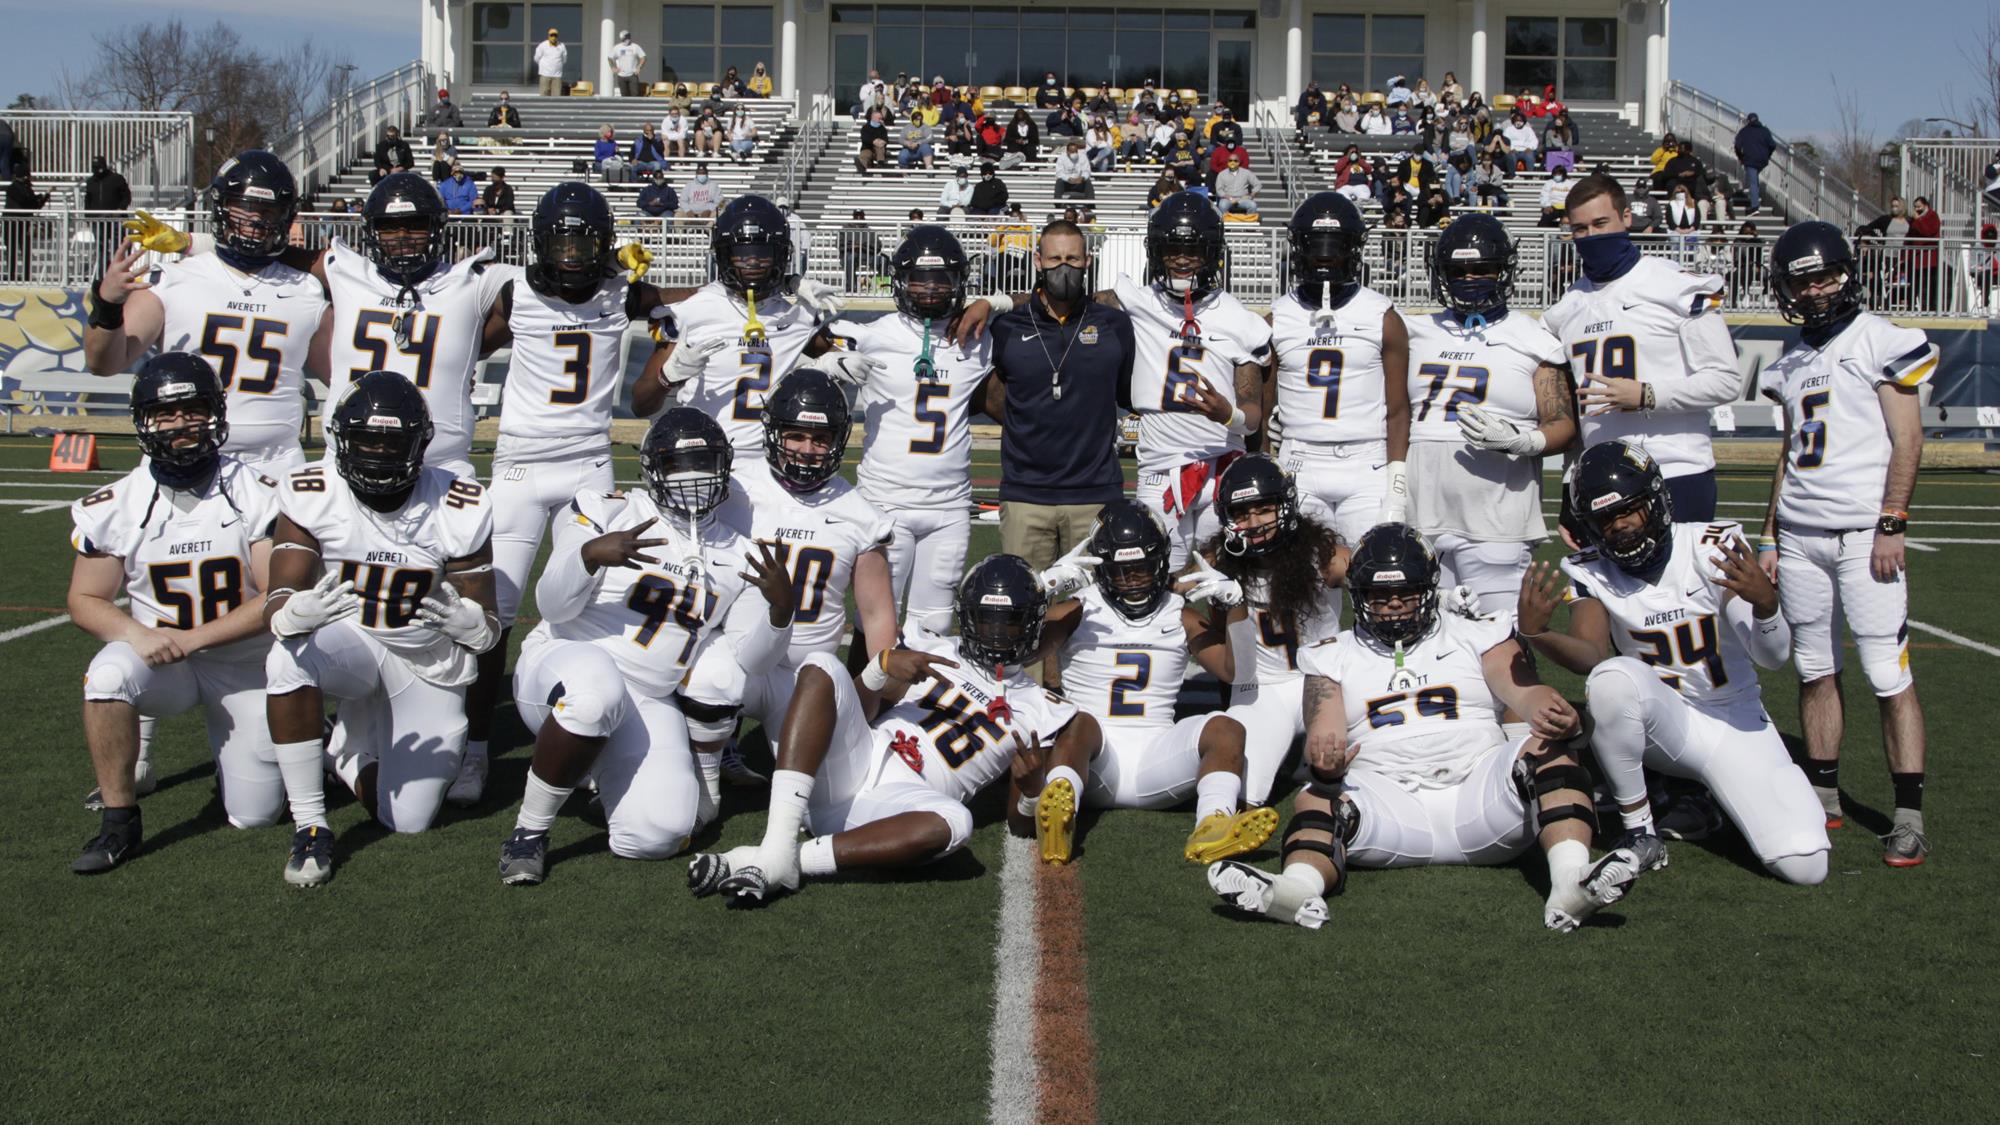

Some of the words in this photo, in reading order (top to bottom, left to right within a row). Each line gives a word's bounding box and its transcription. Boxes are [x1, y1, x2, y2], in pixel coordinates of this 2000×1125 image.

[227, 301, 267, 312] AVERETT
[379, 297, 413, 309] AVEET
[1584, 320, 1613, 334] AVERETT
[200, 312, 289, 395] 55
[349, 308, 442, 389] 54
[548, 331, 592, 406] 3
[1306, 336, 1344, 347] AVERETT
[1438, 350, 1476, 361] AVERETT
[732, 351, 772, 422] 2
[1161, 346, 1204, 413] 6
[1306, 348, 1344, 418] 9
[1418, 361, 1490, 422] 72
[55, 434, 89, 464] 40
[372, 418, 398, 426] Riddell
[908, 383, 952, 455] 5
[1234, 489, 1256, 499] Riddell
[1592, 494, 1617, 507] Riddell
[169, 540, 212, 555] AVERETT
[774, 527, 815, 540] AVERETT
[1117, 551, 1141, 559] Riddell
[149, 556, 243, 631] 58
[339, 560, 435, 630] 48
[628, 572, 721, 667] 94
[1644, 607, 1686, 627] AVERETT
[1627, 613, 1730, 692] 24
[1109, 651, 1152, 718] 2
[917, 678, 1009, 772] 46
